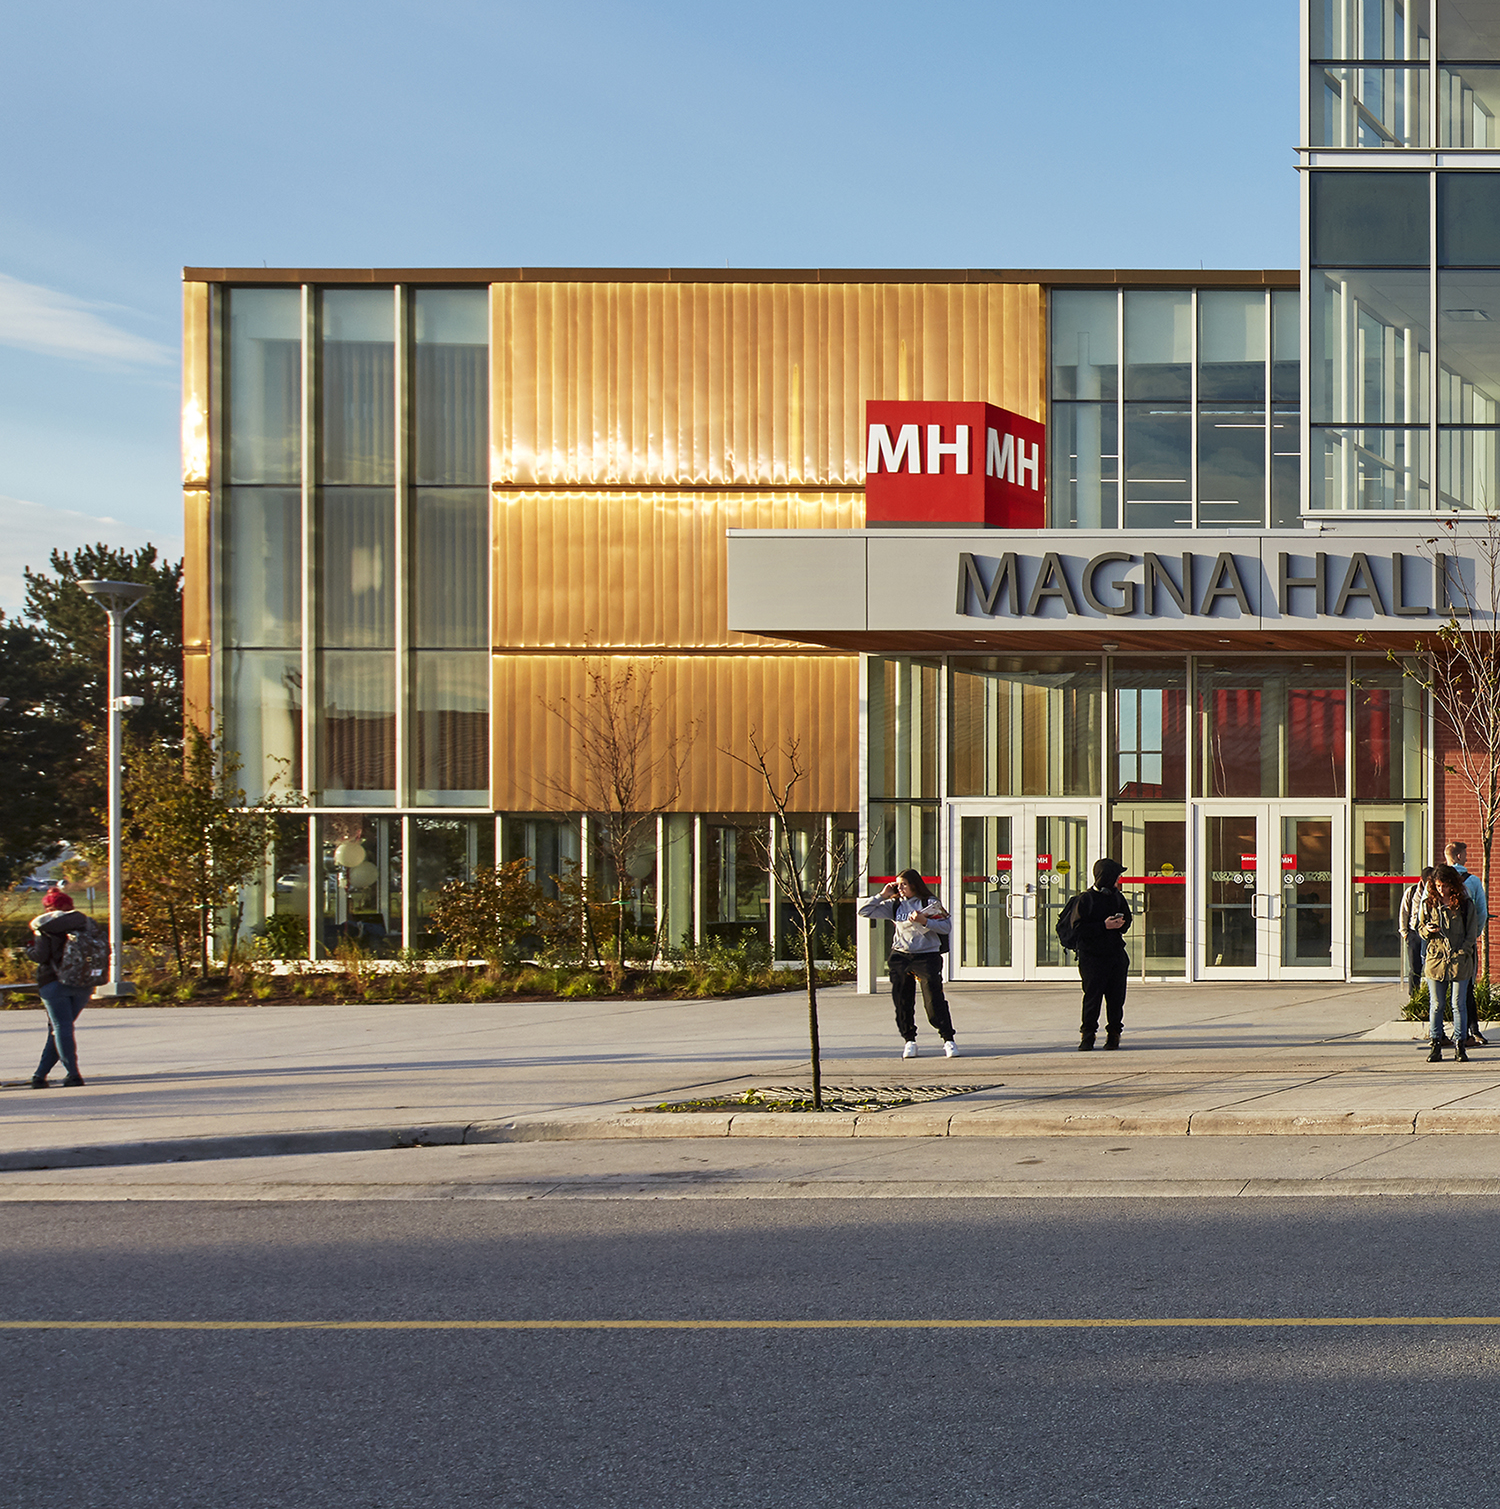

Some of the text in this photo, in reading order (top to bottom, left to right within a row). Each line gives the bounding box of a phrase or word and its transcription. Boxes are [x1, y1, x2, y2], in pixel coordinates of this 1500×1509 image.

[866, 423, 969, 475] MH
[986, 426, 1039, 491] MH
[954, 551, 1472, 617] MAGNA HALL
